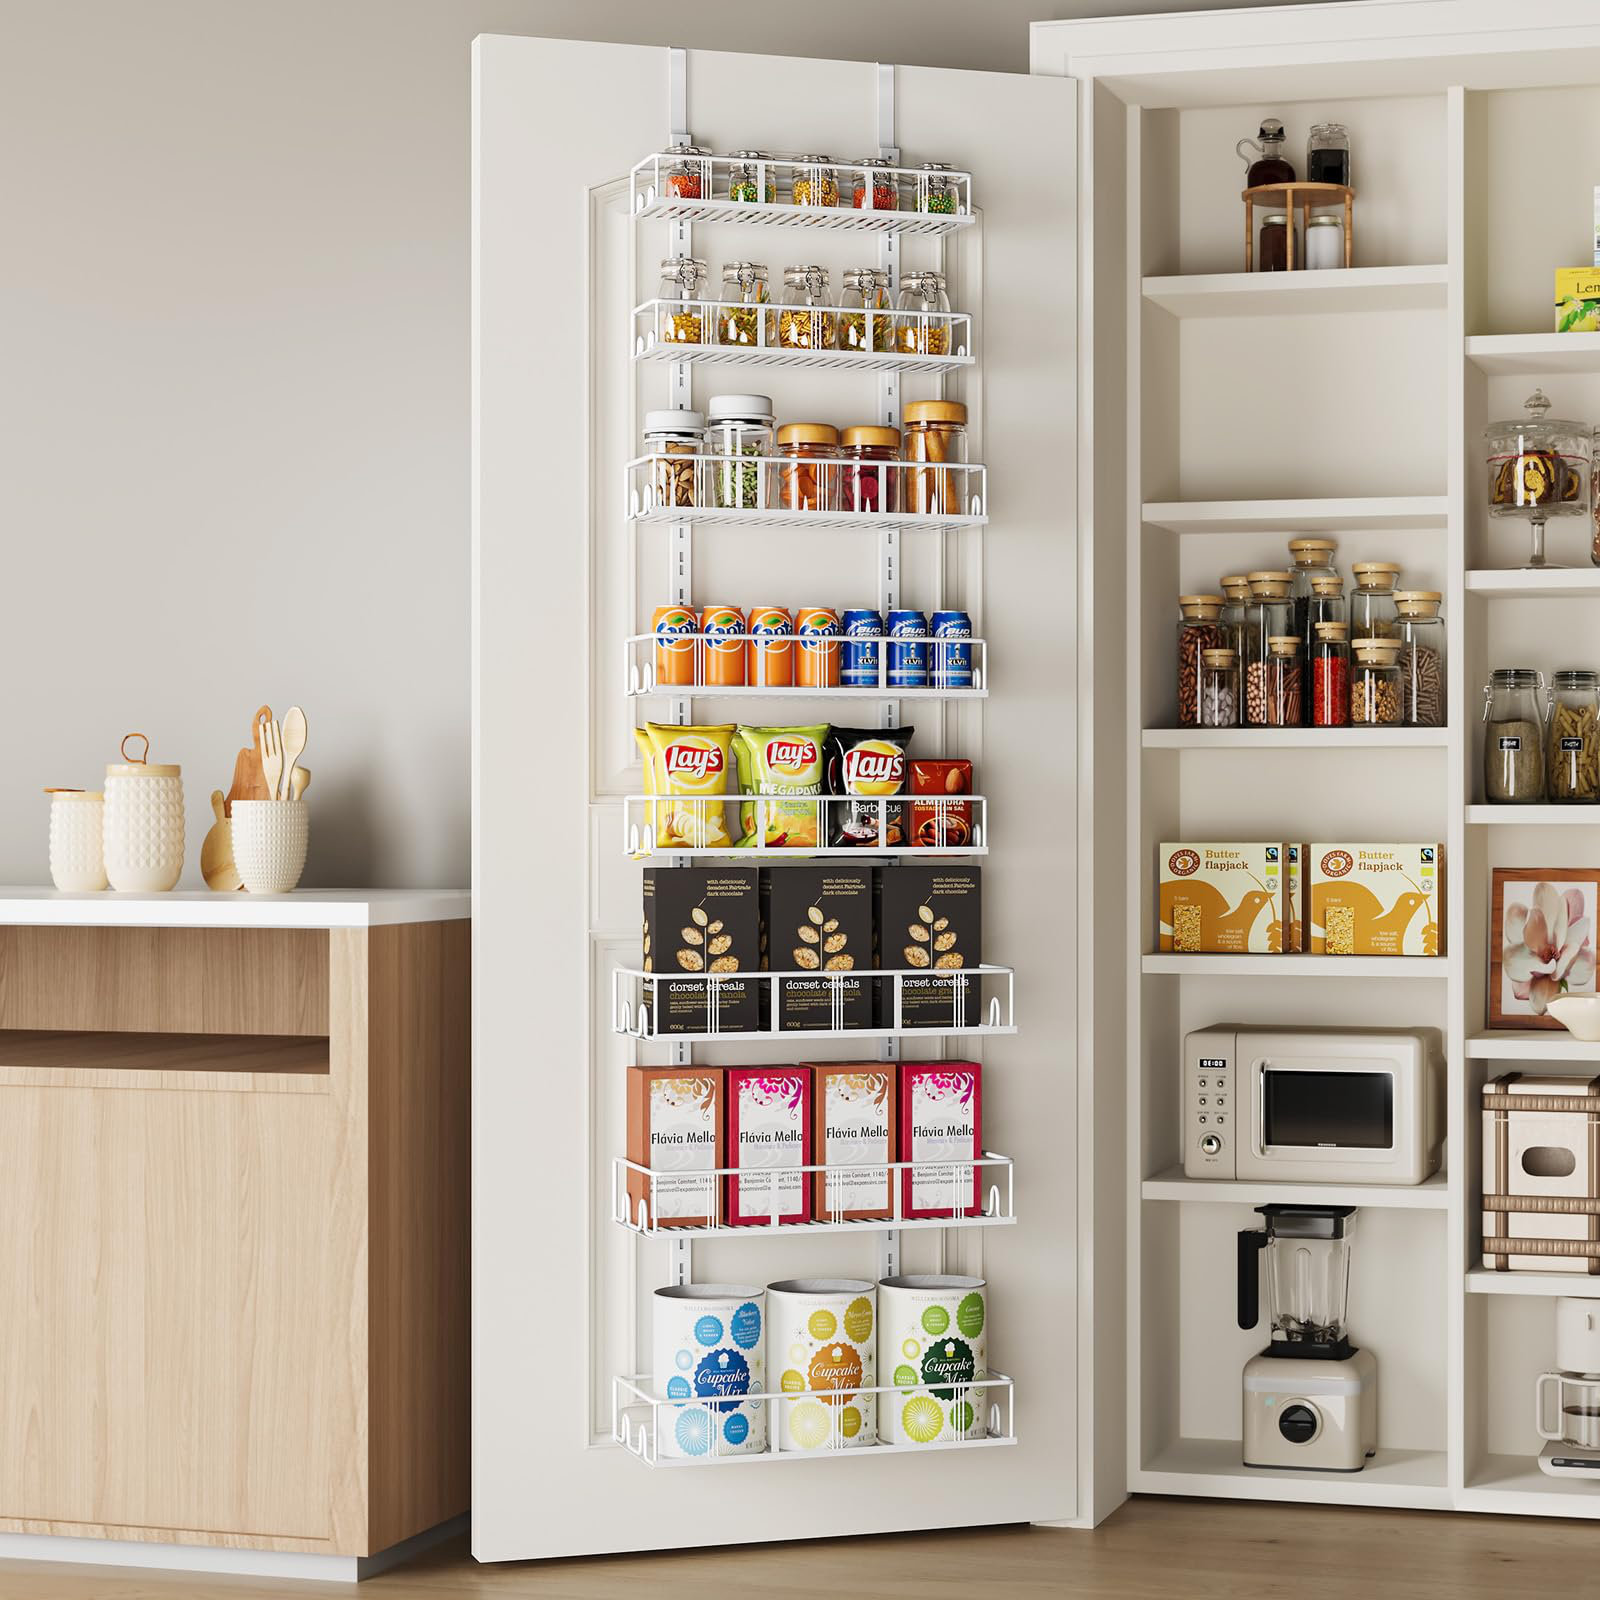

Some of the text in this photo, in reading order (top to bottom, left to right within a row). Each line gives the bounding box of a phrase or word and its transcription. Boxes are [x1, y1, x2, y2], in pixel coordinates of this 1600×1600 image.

[770, 741, 814, 770] Lay's
[668, 746, 720, 779] Lay's
[848, 751, 904, 782] Lay's
[853, 802, 902, 813] Barbcue
[1205, 850, 1240, 858] Butter
[1358, 851, 1394, 860] Butter
[1205, 861, 1249, 871] flapjack
[1358, 862, 1403, 872] flapjack
[669, 982, 704, 992] dorset
[786, 980, 820, 989] dorset
[670, 992, 707, 1000] chocolat
[740, 1130, 803, 1143] Flávia Mello
[826, 1125, 888, 1138] Flávia Mello
[913, 1124, 974, 1137] Flávia Mello
[651, 1131, 716, 1144] Flávia Mello
[811, 1362, 859, 1381] Cupcake
[925, 1357, 972, 1375] Cupcake
[697, 1368, 747, 1387] Cupcake
[830, 1377, 856, 1389] Mix
[943, 1372, 968, 1383] Mix
[713, 1383, 742, 1397] Mix
